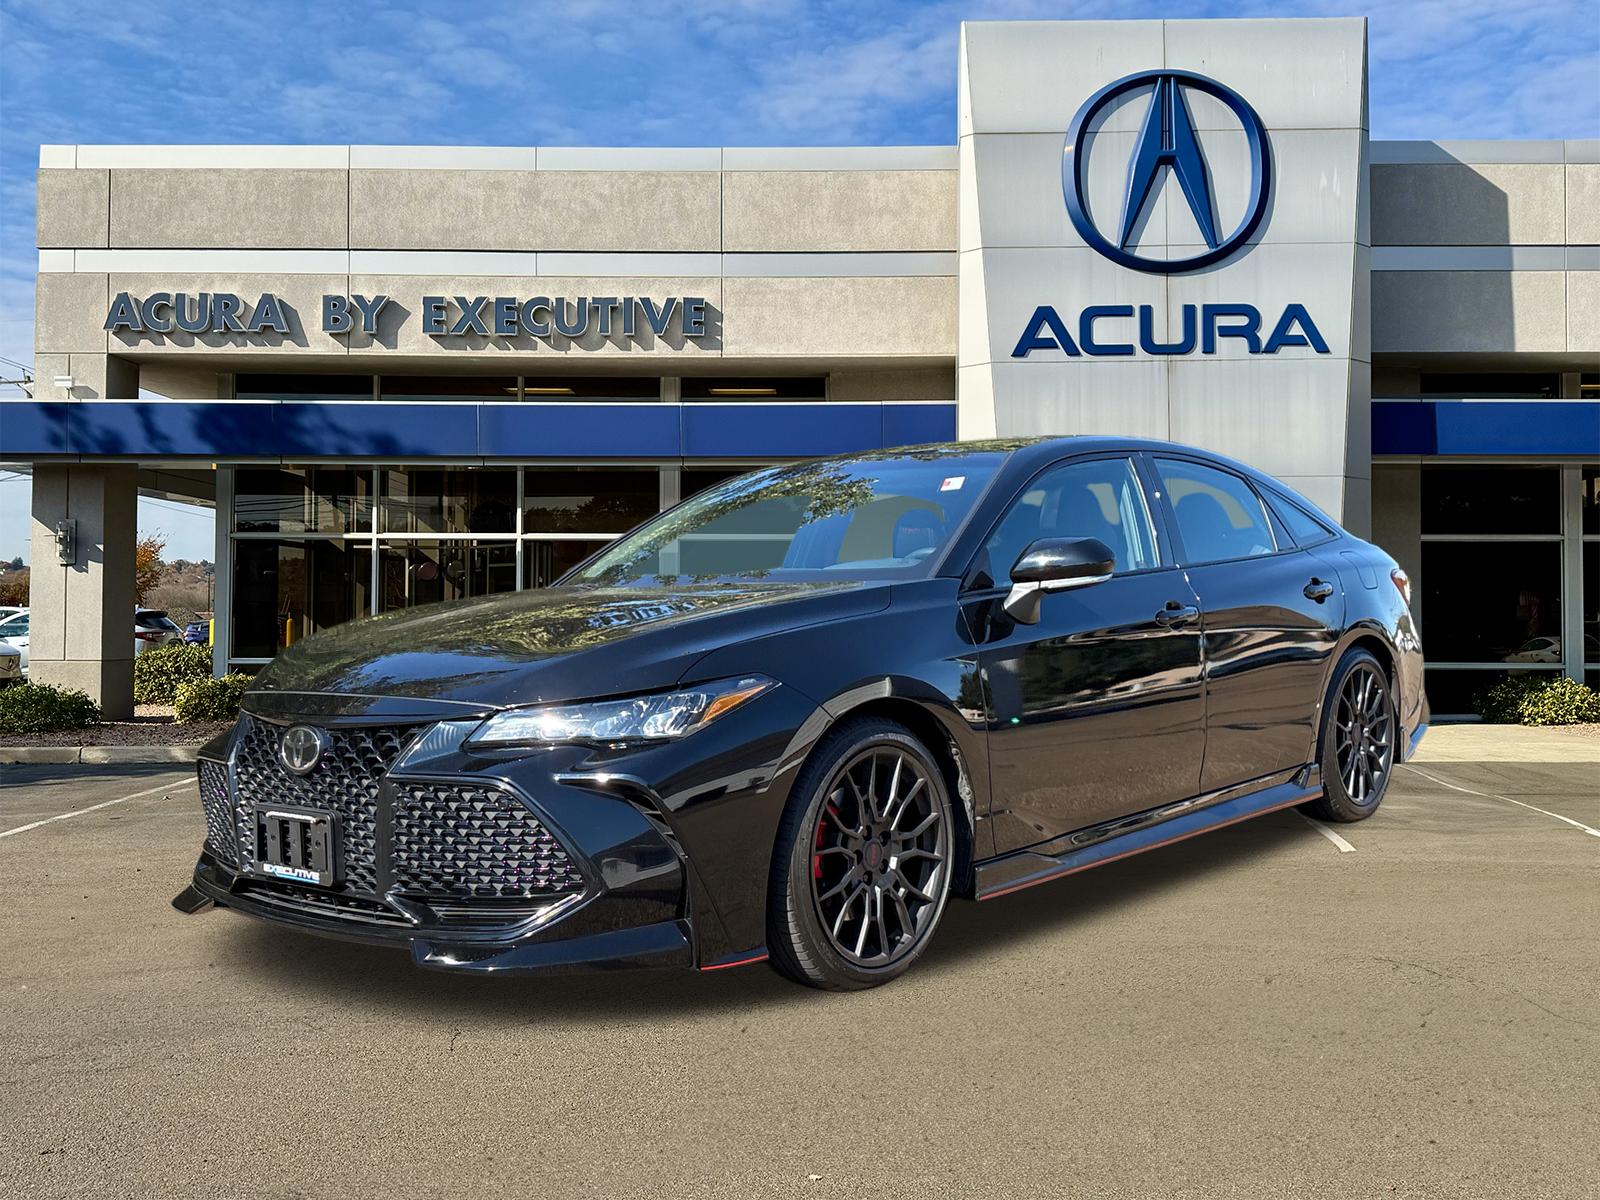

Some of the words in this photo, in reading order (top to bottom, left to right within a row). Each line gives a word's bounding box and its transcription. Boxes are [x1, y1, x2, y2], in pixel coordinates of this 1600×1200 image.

[104, 292, 290, 333] ACURA
[322, 294, 391, 333] BY
[423, 296, 707, 337] EXECUTIVE
[1010, 303, 1331, 356] ACURA
[263, 863, 320, 881] EXECUTIVE
